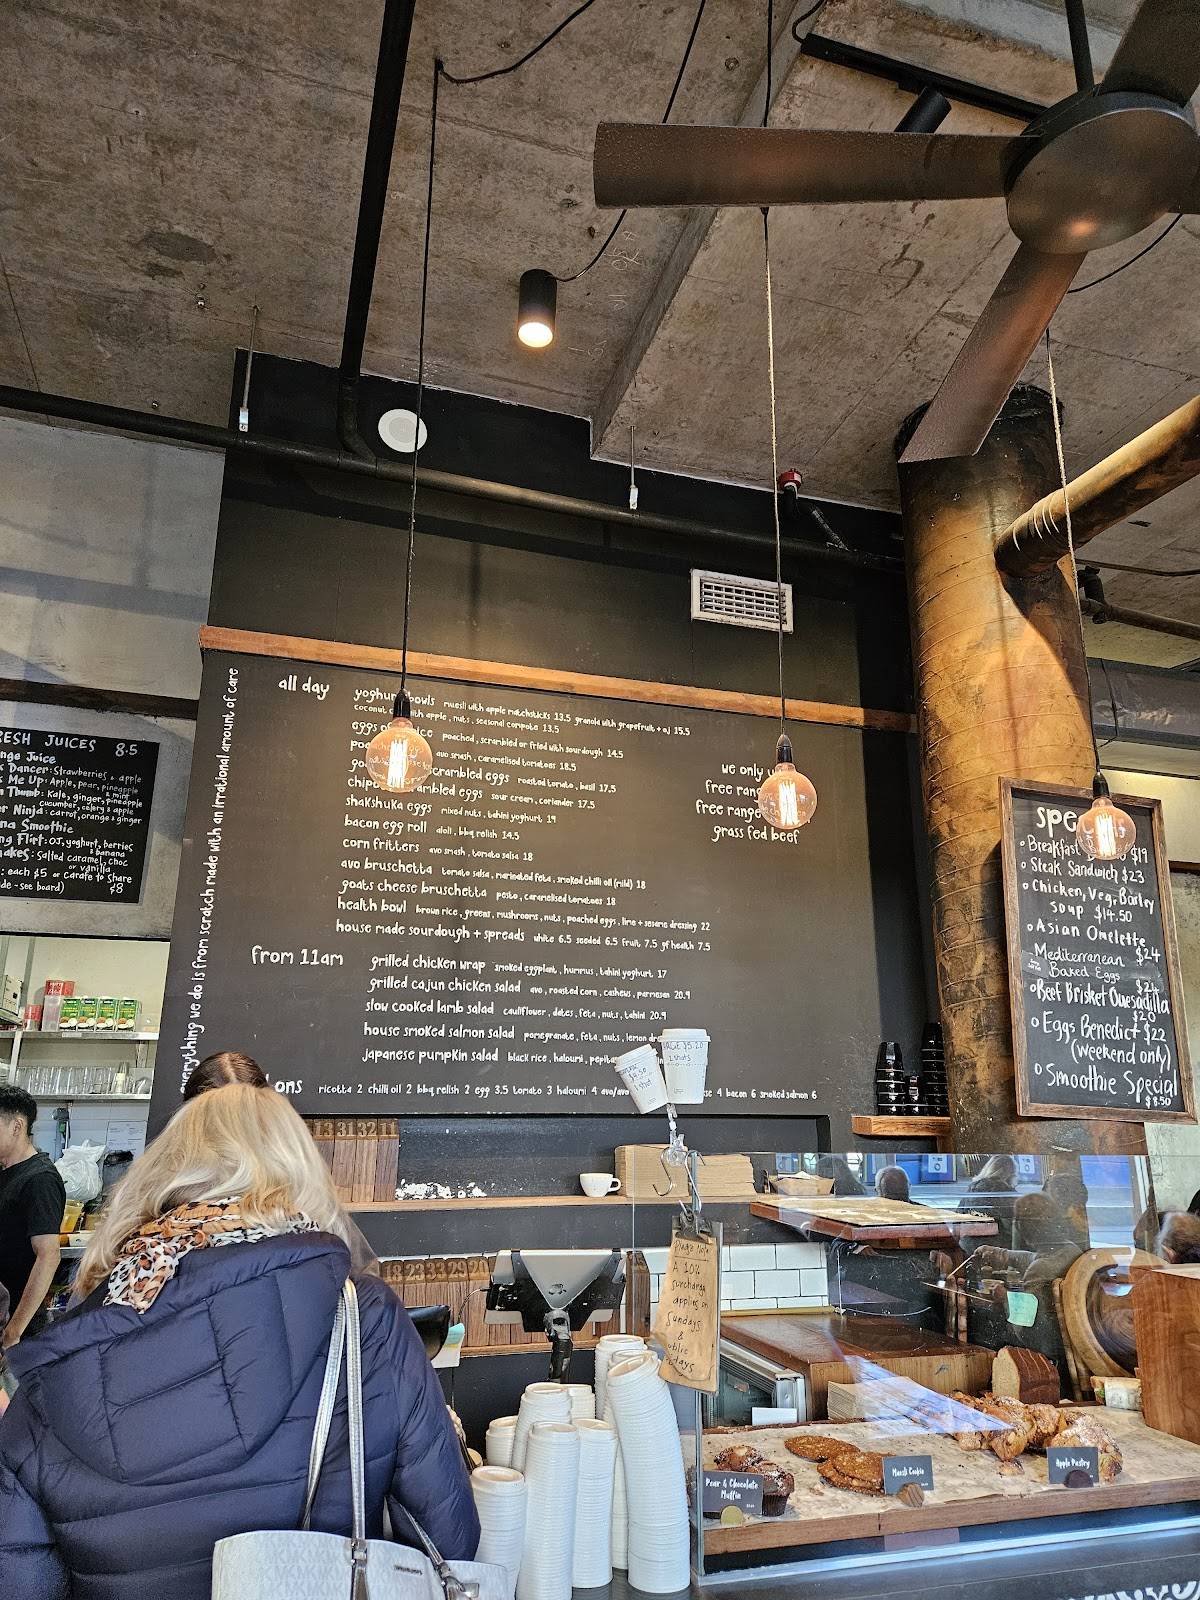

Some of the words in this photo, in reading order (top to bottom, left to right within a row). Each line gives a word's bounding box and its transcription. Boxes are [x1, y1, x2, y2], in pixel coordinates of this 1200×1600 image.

[228, 668, 238, 693] care
[279, 675, 297, 691] all
[302, 677, 329, 700] day
[223, 695, 237, 708] of
[354, 705, 387, 714] coconut
[407, 691, 435, 705] bowls
[486, 706, 506, 715] apple
[221, 711, 235, 752] amount
[352, 722, 377, 735] eggs
[45, 735, 96, 752] JUICES
[116, 743, 137, 757] 8.5
[26, 752, 56, 764] Juice
[8, 774, 24, 784] Me
[50, 777, 76, 788] Apple,
[53, 766, 107, 781] Strawberries
[119, 774, 141, 784] apple
[212, 755, 229, 808] irrational
[485, 772, 509, 785] eggs
[722, 764, 735, 774] we
[740, 764, 763, 782] only
[459, 789, 482, 802] eggs
[706, 779, 732, 794] free
[113, 808, 133, 817] apple
[407, 803, 432, 816] eggs
[441, 807, 463, 815] mixed
[510, 813, 542, 824] yoghurt
[696, 799, 723, 815] free
[21, 818, 73, 835] Smoothie
[81, 814, 109, 823] orange
[117, 817, 142, 826] ginger
[213, 812, 223, 824] an
[345, 814, 379, 829] bacon
[383, 821, 404, 835] egg
[408, 821, 426, 832] roll
[502, 831, 519, 840] 14.5
[207, 828, 221, 851] with
[712, 826, 743, 842] grass
[748, 825, 767, 840] fed
[771, 827, 799, 844] beef
[66, 837, 101, 850] yoghurt,
[103, 840, 133, 852] berries
[96, 848, 125, 857] banana
[343, 839, 369, 849] corn
[374, 838, 419, 852] fritters
[472, 849, 500, 858] tomato
[502, 851, 519, 859] salsa
[1027, 833, 1081, 860] Breakfast
[1131, 845, 1147, 865] $19
[37, 850, 63, 861] Salted
[8, 867, 30, 876] each
[34, 868, 47, 879] $5
[96, 871, 104, 882] to
[203, 856, 218, 885] made
[341, 860, 360, 869] avo
[364, 857, 432, 874] bruschetta
[442, 867, 470, 877] tomato
[1031, 857, 1062, 875] Steak
[1068, 859, 1118, 884] Sandwich
[1122, 866, 1144, 884] $23
[37, 881, 64, 894] board)
[110, 883, 123, 894] $8
[338, 879, 374, 894] goats
[377, 879, 417, 893] cheese
[421, 881, 486, 897] bruschetta
[1032, 879, 1086, 901] Chicken,
[200, 889, 214, 934] scratch
[338, 896, 377, 911] health
[381, 899, 406, 913] bowl
[416, 905, 439, 915] brown
[567, 914, 598, 925] poached
[1094, 904, 1132, 924] $14.50
[336, 919, 371, 933] house
[376, 922, 405, 934] made
[409, 924, 470, 943] sourdough
[474, 930, 481, 938] +
[484, 928, 524, 942] spreads
[1037, 918, 1080, 937] Asian
[1087, 925, 1145, 947] Omelette
[192, 939, 208, 968] from
[252, 945, 293, 964] from
[300, 949, 343, 966] 11am
[1033, 943, 1125, 968] Mediterranean
[1136, 946, 1160, 966] $24
[192, 972, 205, 980] is
[369, 954, 409, 971] grilled
[413, 954, 456, 969] chicken
[460, 961, 485, 974] wrap
[600, 967, 620, 976] tahini
[622, 968, 653, 980] yoghurt
[1049, 961, 1089, 977] Baked
[1095, 966, 1120, 984] Eggs
[188, 985, 202, 999] do
[367, 976, 408, 992] grilled
[412, 979, 444, 992] cajun
[448, 977, 491, 992] chicken
[494, 980, 520, 992] salad
[549, 986, 578, 995] roasted
[1037, 978, 1062, 1001] Beef
[1066, 982, 1108, 1006] Brisket
[190, 1003, 201, 1018] we
[366, 998, 388, 1011] slow
[392, 1000, 433, 1012] cooked
[437, 1000, 463, 1013] lamb
[467, 1001, 493, 1014] salad
[625, 1010, 645, 1019] tahini
[1132, 1010, 1156, 1022] $20
[364, 1022, 400, 1036] house
[404, 1024, 445, 1037] smoked
[449, 1024, 484, 1038] salmon
[488, 1026, 514, 1038] salad
[626, 1033, 647, 1041] lemon
[1043, 1011, 1076, 1045] Eggs
[1081, 1014, 1141, 1040] Benedict
[1144, 1021, 1166, 1045] $22
[362, 1049, 415, 1063] japanese
[419, 1049, 467, 1064] pumpkin
[471, 1048, 498, 1061] salad
[1071, 1038, 1135, 1064] (weekend
[1140, 1044, 1170, 1073] only)
[319, 1085, 351, 1093] ricotta
[391, 1084, 401, 1093] oil
[475, 1087, 490, 1098] egg
[513, 1086, 542, 1095] tomato
[1046, 1063, 1117, 1094] Smoothie
[1123, 1068, 1177, 1103] Special
[726, 1088, 747, 1097] bacon
[337, 1121, 356, 1136] 31
[358, 1121, 376, 1137] 32
[380, 1122, 397, 1136] 11
[406, 1264, 424, 1280] 23
[448, 1260, 468, 1278] 29
[684, 1264, 700, 1275] 10%
[1056, 1458, 1070, 1469] Apple
[1072, 1458, 1090, 1469] Pastry
[706, 1478, 721, 1487] Pear
[720, 1490, 741, 1500] Muffin
